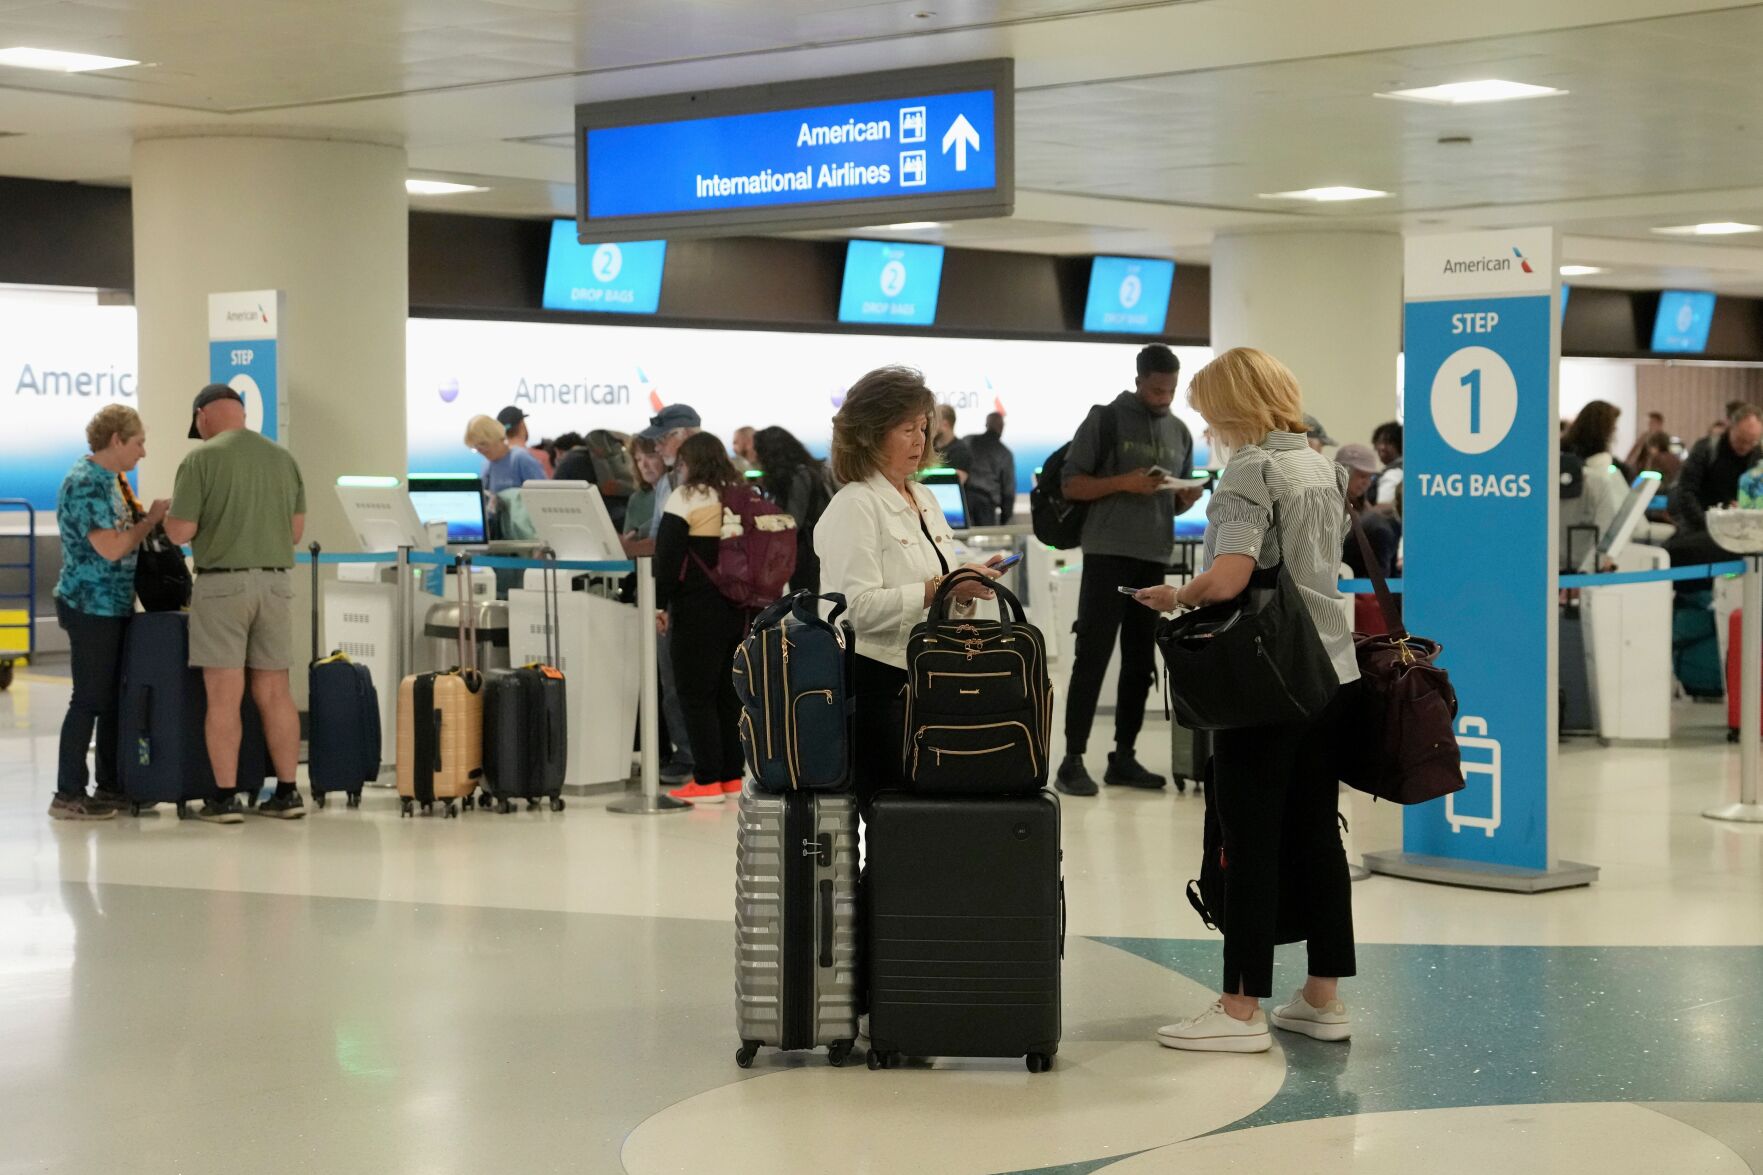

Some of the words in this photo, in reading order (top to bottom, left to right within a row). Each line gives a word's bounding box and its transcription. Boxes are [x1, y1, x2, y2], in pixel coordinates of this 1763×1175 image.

[797, 117, 891, 147] American
[696, 165, 812, 197] International
[817, 161, 891, 188] Airlines
[601, 251, 613, 275] 2
[1443, 255, 1511, 274] American
[887, 268, 898, 290] 2
[571, 287, 602, 301] DROP
[605, 289, 634, 303] BAGS
[226, 311, 258, 322] American
[1451, 311, 1499, 334] STEP
[231, 349, 254, 366] STEP
[15, 363, 138, 397] Americ
[513, 377, 631, 405] American
[1459, 368, 1481, 434] 1
[1418, 473, 1464, 497] TAG
[1470, 473, 1531, 498] BAGS
